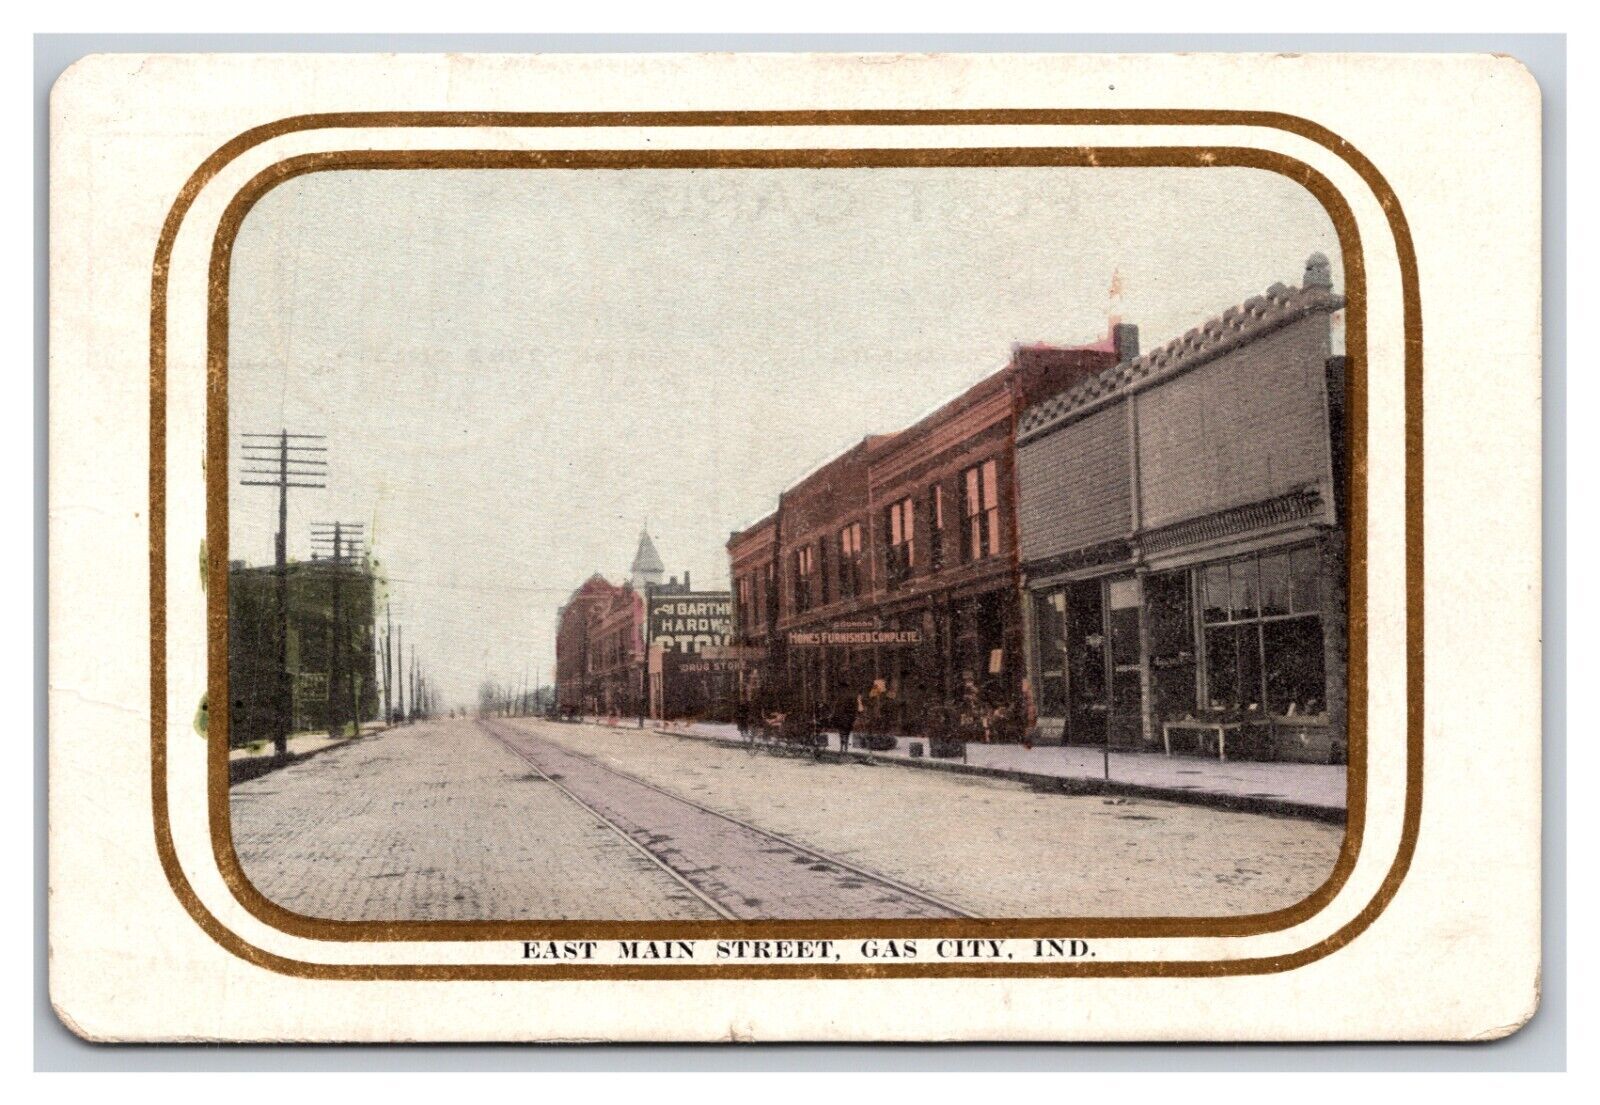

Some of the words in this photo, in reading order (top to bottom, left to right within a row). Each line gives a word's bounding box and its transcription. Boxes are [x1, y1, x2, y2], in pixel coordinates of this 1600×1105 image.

[661, 618, 731, 632] HARDW
[821, 631, 871, 644] FURNISHED
[680, 663, 710, 673] DRUG
